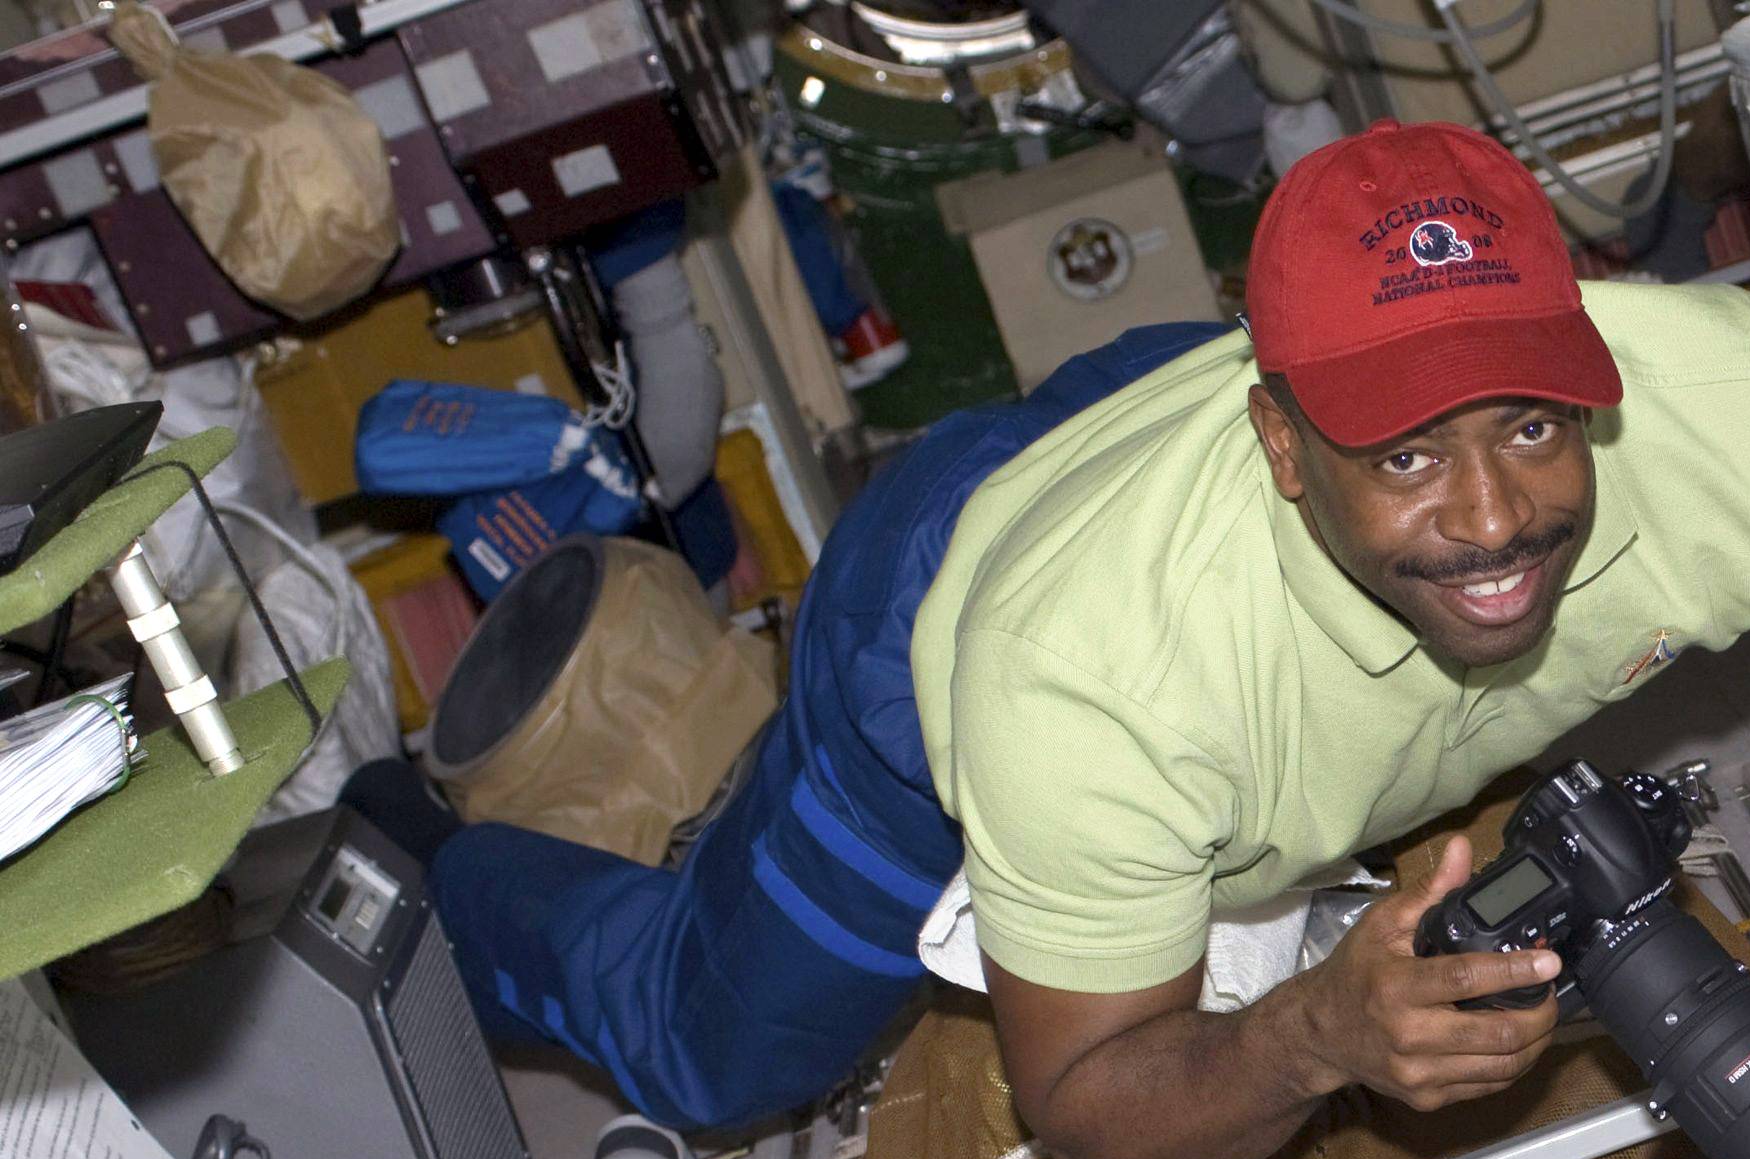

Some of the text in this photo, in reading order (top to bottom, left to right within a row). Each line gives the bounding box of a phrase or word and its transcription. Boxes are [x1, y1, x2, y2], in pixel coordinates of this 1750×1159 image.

[1359, 196, 1505, 252] RICHMOND
[1372, 272, 1521, 306] NATIONAL CHAMPIONS
[1379, 268, 1421, 290] NCAA
[1446, 258, 1513, 276] FOOTBALL
[1624, 878, 1672, 915] Nikon
